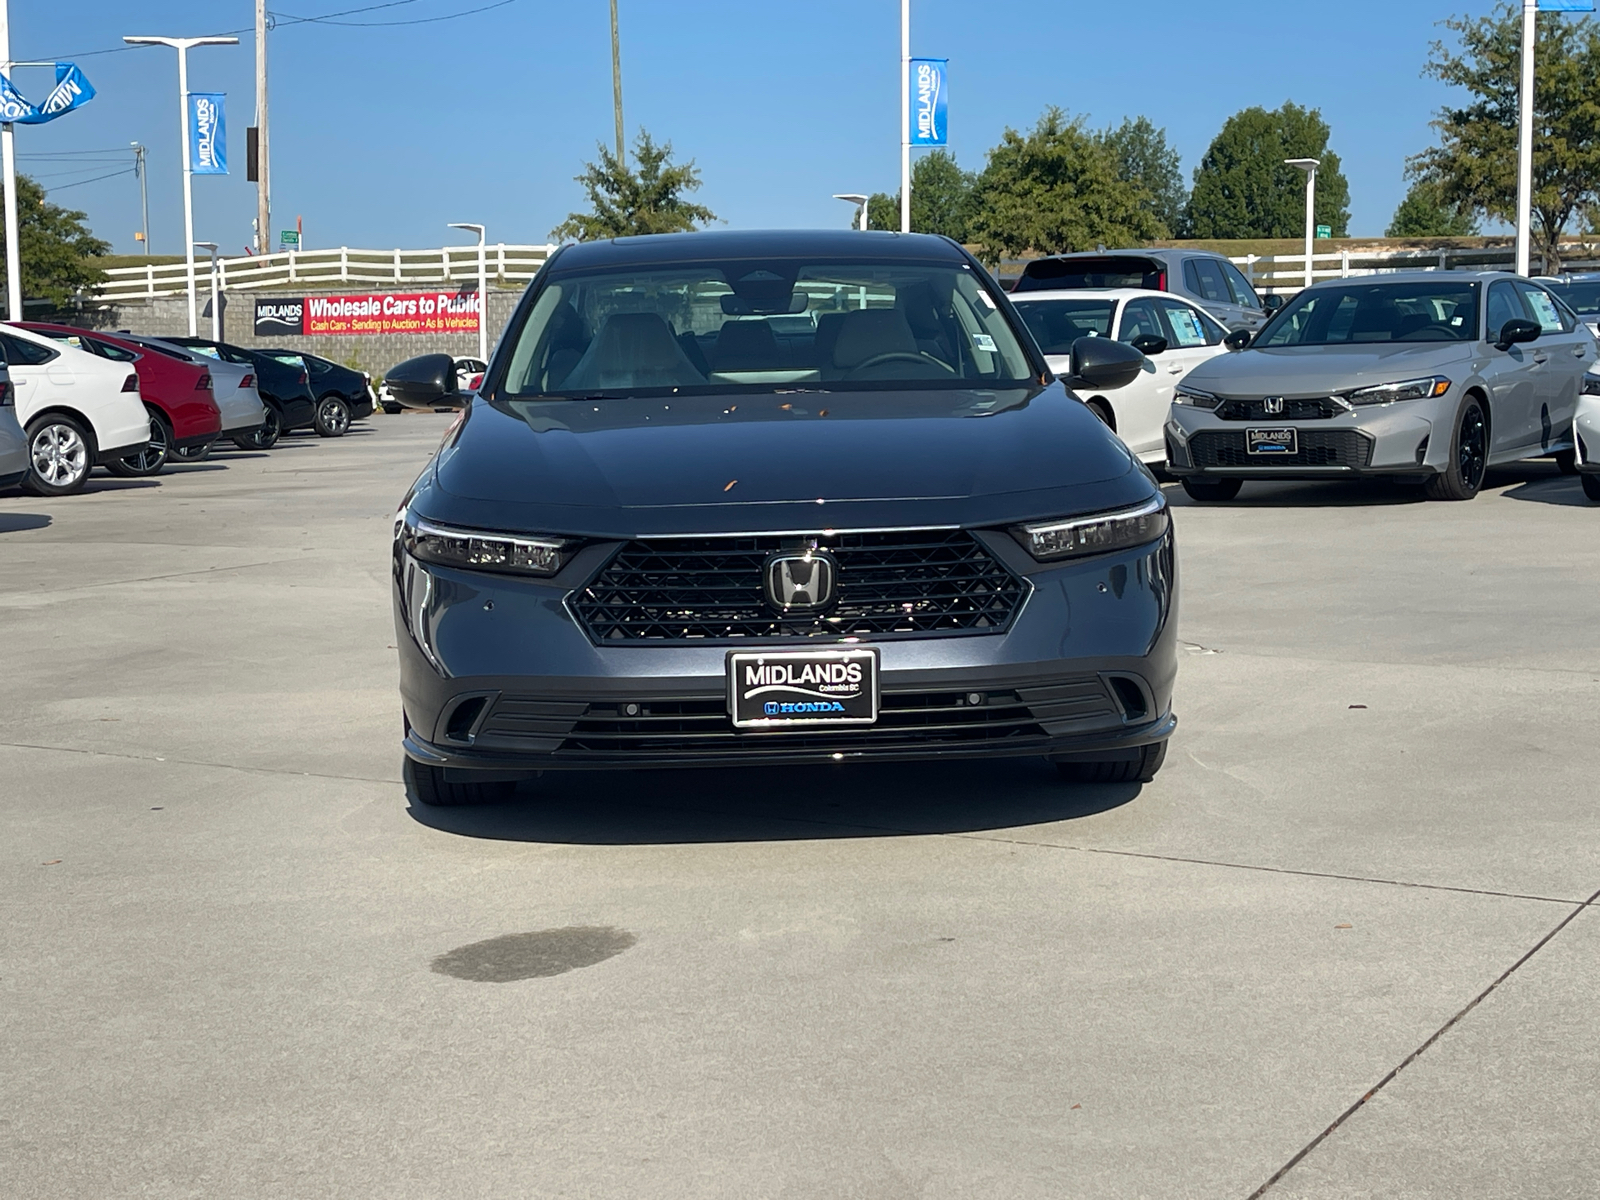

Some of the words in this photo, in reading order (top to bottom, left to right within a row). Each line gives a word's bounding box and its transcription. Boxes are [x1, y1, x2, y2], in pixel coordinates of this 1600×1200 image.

[47, 79, 82, 114] MID
[918, 64, 930, 138] MIDLANDS
[197, 98, 211, 166] MIDLANDS
[257, 304, 303, 317] MIDLANDS
[308, 296, 381, 317] Wholesale
[383, 296, 417, 315] Cars
[418, 296, 435, 314] to
[310, 320, 329, 331] Cash
[329, 319, 347, 330] Cars
[351, 319, 381, 333] Sending
[382, 320, 390, 329] to
[391, 318, 420, 329] Auction
[425, 318, 436, 328] As
[437, 317, 444, 328] Is
[445, 317, 478, 328] Vehicles
[1251, 432, 1291, 440] MIDLANDS
[746, 663, 862, 685] MIDLANDS
[818, 684, 849, 692] Columbia
[780, 701, 845, 713] HONDA
